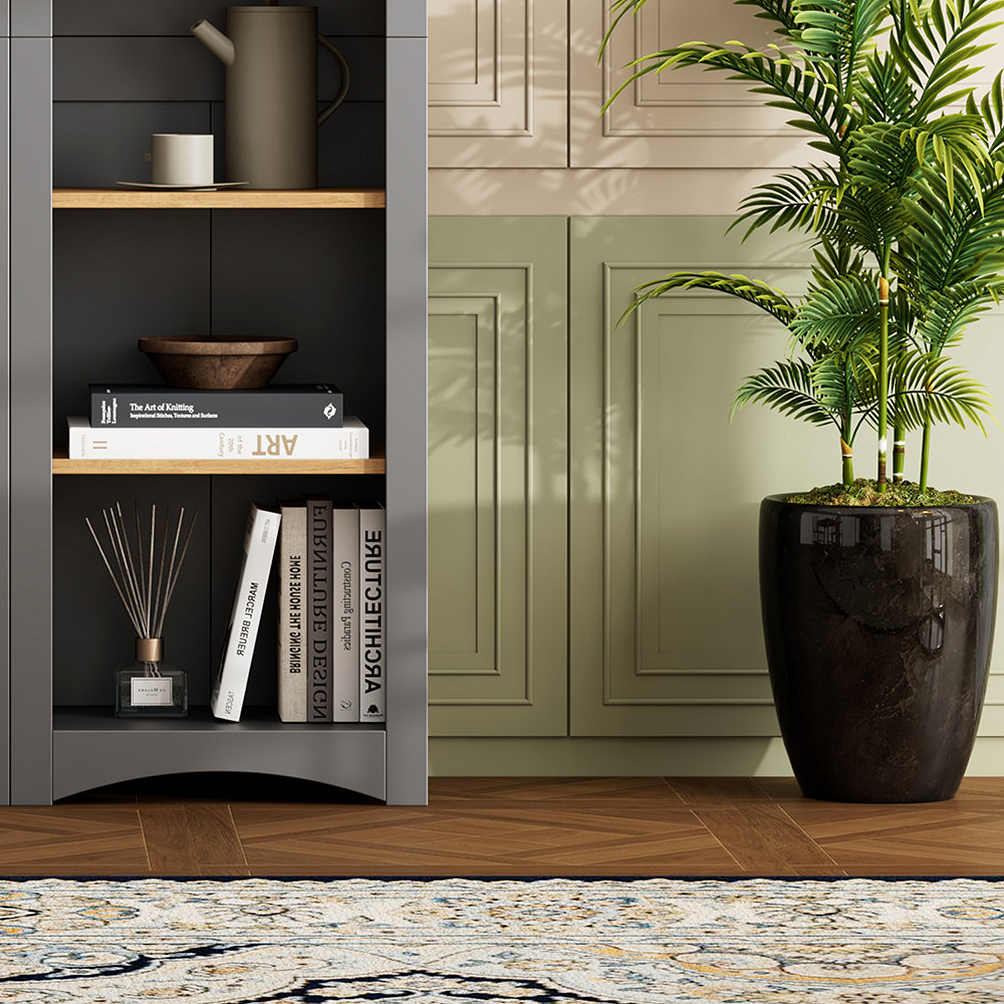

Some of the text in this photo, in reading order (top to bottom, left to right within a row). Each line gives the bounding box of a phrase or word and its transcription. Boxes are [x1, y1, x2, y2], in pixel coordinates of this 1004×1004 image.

[129, 402, 195, 414] The Art of Knitting
[251, 434, 299, 457] ART
